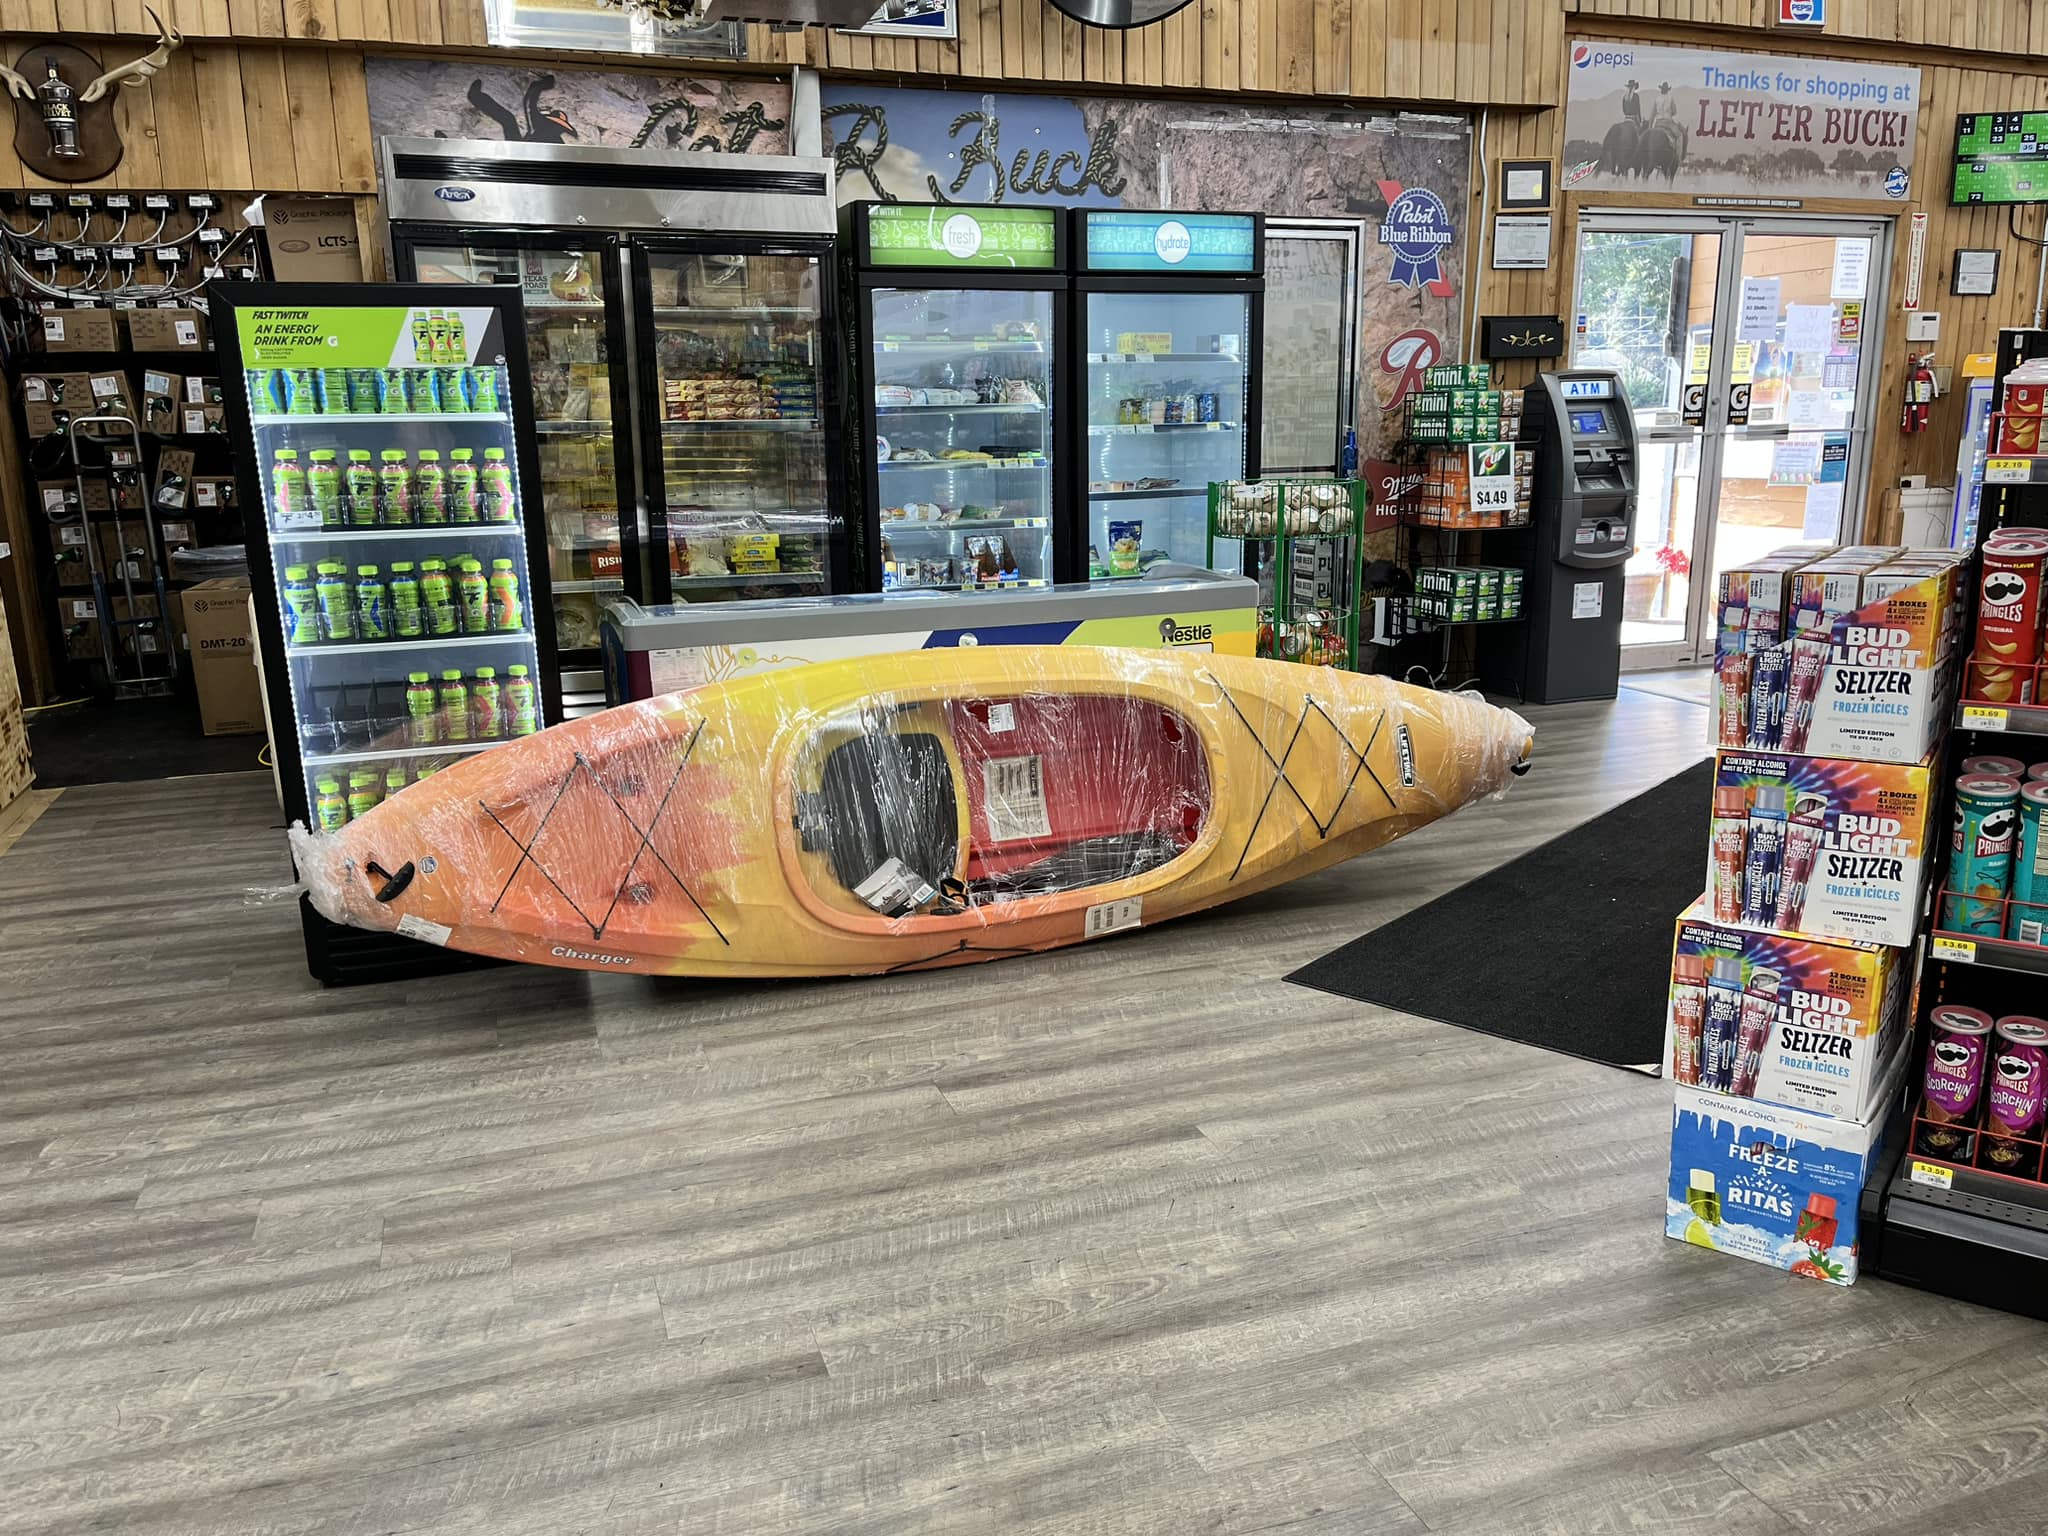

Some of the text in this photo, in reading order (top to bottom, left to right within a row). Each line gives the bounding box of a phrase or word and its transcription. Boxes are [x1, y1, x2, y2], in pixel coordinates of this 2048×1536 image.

[1594, 52, 1634, 68] pepsi
[1702, 66, 1911, 104] Thanks for shopping at
[1822, 108, 1908, 148] BUCK!
[1398, 199, 1435, 225] Pabst
[948, 226, 975, 245] fresh
[1380, 226, 1452, 245] Blue Ribbon
[253, 311, 309, 320] FAST TWITCH
[255, 324, 319, 334] AN ENERGY
[254, 336, 289, 346] DRINK
[290, 336, 323, 346] FROM
[1433, 366, 1463, 386] mini
[1570, 383, 1600, 395] ATM
[1422, 393, 1448, 412] mini
[1420, 419, 1446, 437] mini
[1477, 490, 1507, 505] $4.49
[1423, 572, 1450, 592] mini
[1421, 598, 1448, 617] mni
[1980, 600, 2023, 623] PRINGLES
[201, 638, 246, 649] DMT-20
[1846, 627, 1911, 648] BUD
[1760, 663, 1784, 671] SELTZER
[1793, 661, 1820, 670] LIGHT
[1798, 656, 1817, 664] BUD
[1831, 649, 1922, 669] LIGHT
[1835, 670, 1912, 696] SELTZER
[1755, 681, 1770, 734] FROZEN ICICLES
[1833, 700, 1909, 717] FROZEN ICICLES
[1839, 727, 1895, 738] LIMITED EDITION
[1400, 731, 1413, 779] LIFETIME
[1725, 757, 1787, 770] CONTAINS ALCOHOL
[1722, 764, 1735, 772] MUST
[1744, 765, 1755, 774] 21+
[1764, 767, 1786, 777] CONSUME
[1878, 790, 1917, 799] 12 BOXES
[1838, 814, 1901, 836] BUD
[1753, 838, 1779, 846] LIGHT
[1753, 844, 1777, 853] SELTZER
[1824, 832, 1912, 857] LIGHT
[1828, 854, 1903, 882] SELTZER
[1750, 861, 1763, 911] FROZEN ICICLES
[1826, 883, 1900, 902] FROZEN ICICLES
[1832, 910, 1887, 922] LIMITED EDITION
[1685, 927, 1743, 944] CONTAINS ALCOHOL
[1702, 936, 1713, 945] 21+
[551, 946, 635, 966] Charger
[1830, 971, 1867, 983] 12 BOXES
[1710, 1006, 1735, 1015] LIGHT
[1714, 1001, 1732, 1010] BUD
[1791, 990, 1851, 1014] BUD
[1711, 1011, 1733, 1021] SELTZER
[1778, 1006, 1862, 1036] LIGHT
[1707, 1027, 1720, 1075] FROZEN ICICLES
[1781, 1027, 1853, 1059] SELTZER
[1779, 1055, 1850, 1078] FROZEN ICICLES
[1933, 1058, 1967, 1079] PRINGLES
[1785, 1080, 1838, 1095] LIMITED EDITION
[1996, 1072, 2029, 1093] PRINGLES
[1698, 1097, 1738, 1114] CONTAINS
[1739, 1108, 1777, 1123] ALCOHOL
[1728, 1143, 1799, 1174] FREEZE
[1728, 1187, 1793, 1217] RITAS
